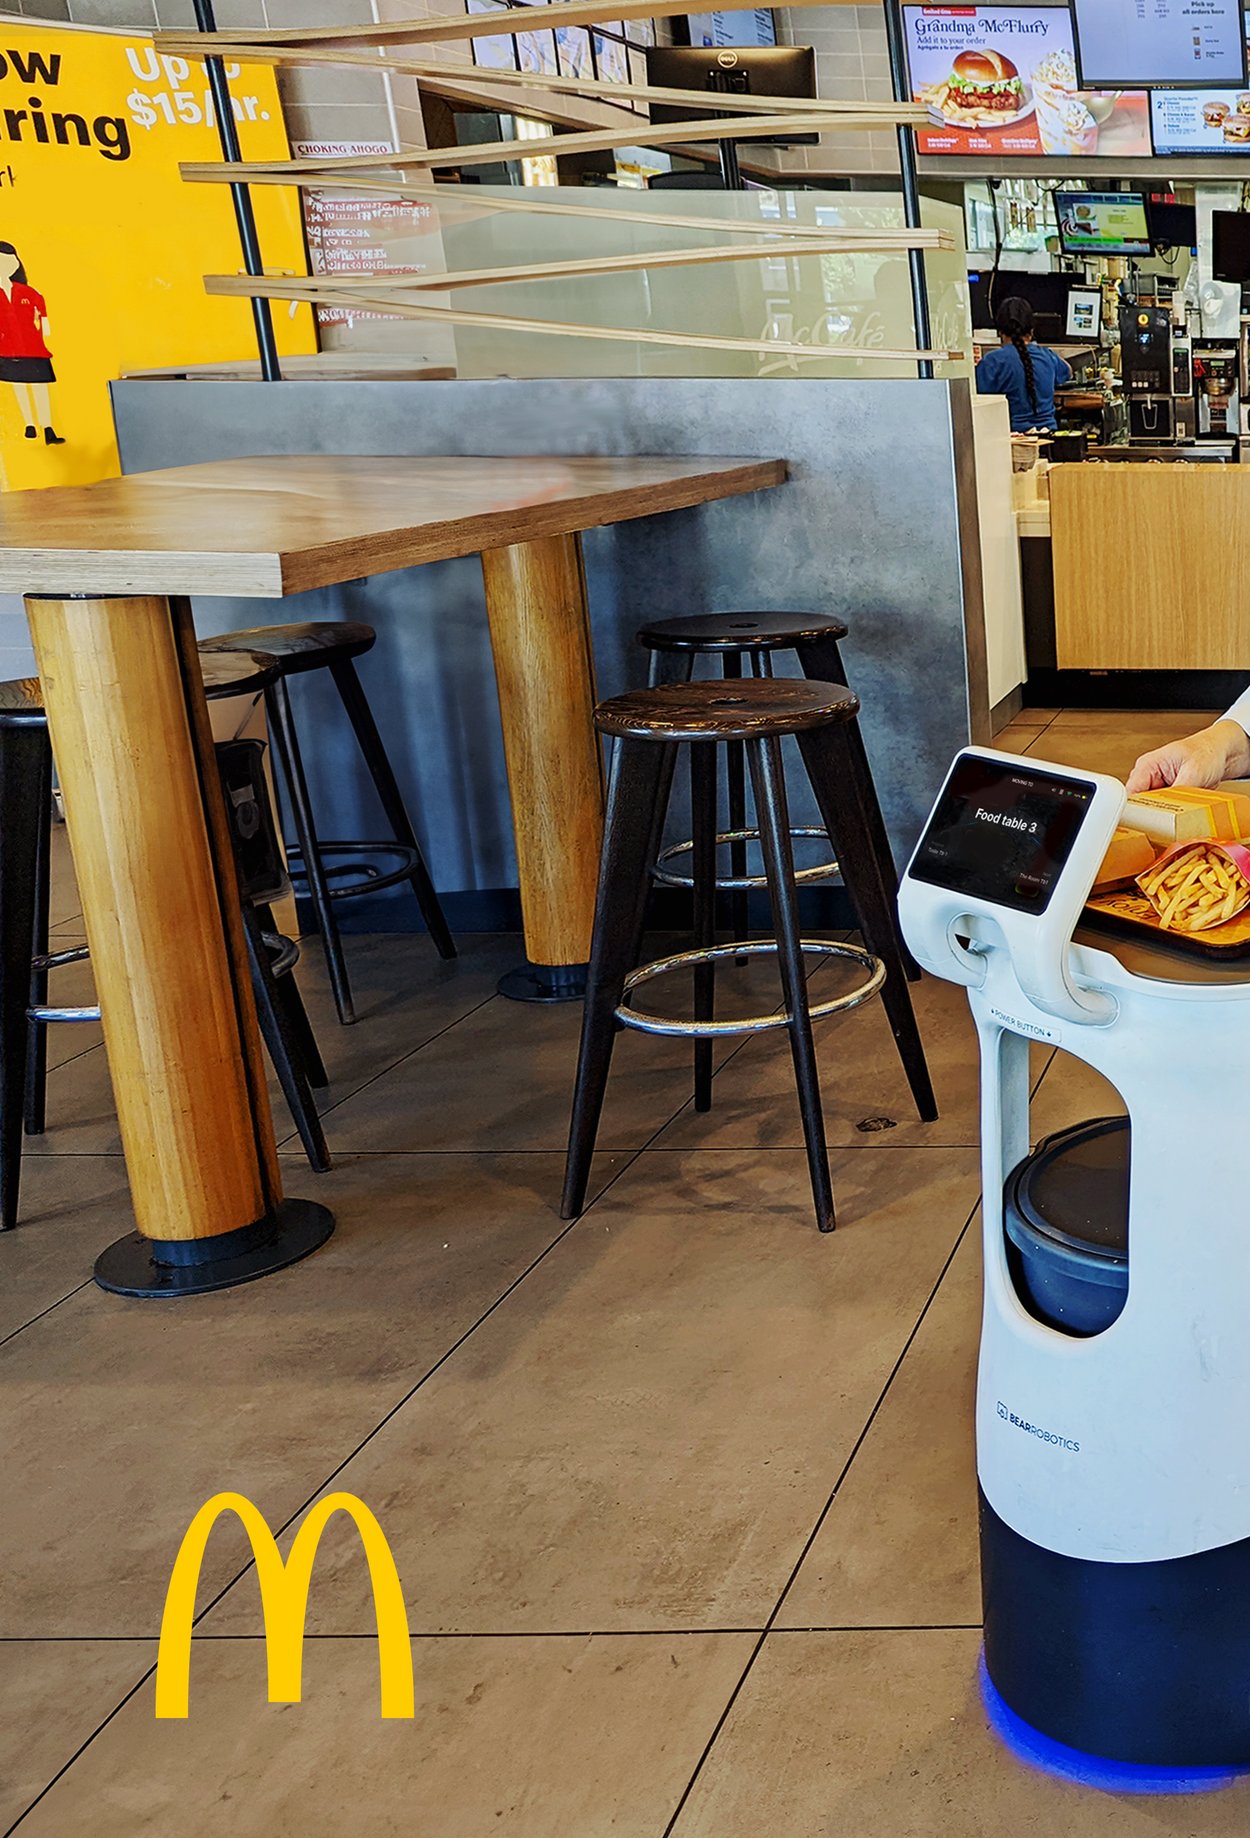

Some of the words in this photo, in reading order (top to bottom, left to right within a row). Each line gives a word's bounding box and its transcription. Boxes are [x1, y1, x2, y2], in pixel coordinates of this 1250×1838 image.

[915, 18, 975, 36] Grandma
[978, 19, 1049, 36] McFlurry
[917, 36, 932, 44] Add
[933, 36, 939, 44] it
[949, 37, 965, 46] your
[966, 36, 986, 44] order
[0, 49, 61, 86] w
[125, 47, 190, 90] Up
[1157, 101, 1163, 109] 2
[0, 96, 131, 161] ring
[297, 144, 347, 154] CHOKING
[350, 145, 388, 153] AHOGO
[1012, 777, 1028, 786] MOVING
[975, 807, 1001, 824] Food
[1001, 815, 1028, 831] table
[1028, 822, 1037, 833] 3
[995, 1009, 1015, 1026] POWER
[1016, 1020, 1046, 1036] BUTTON
